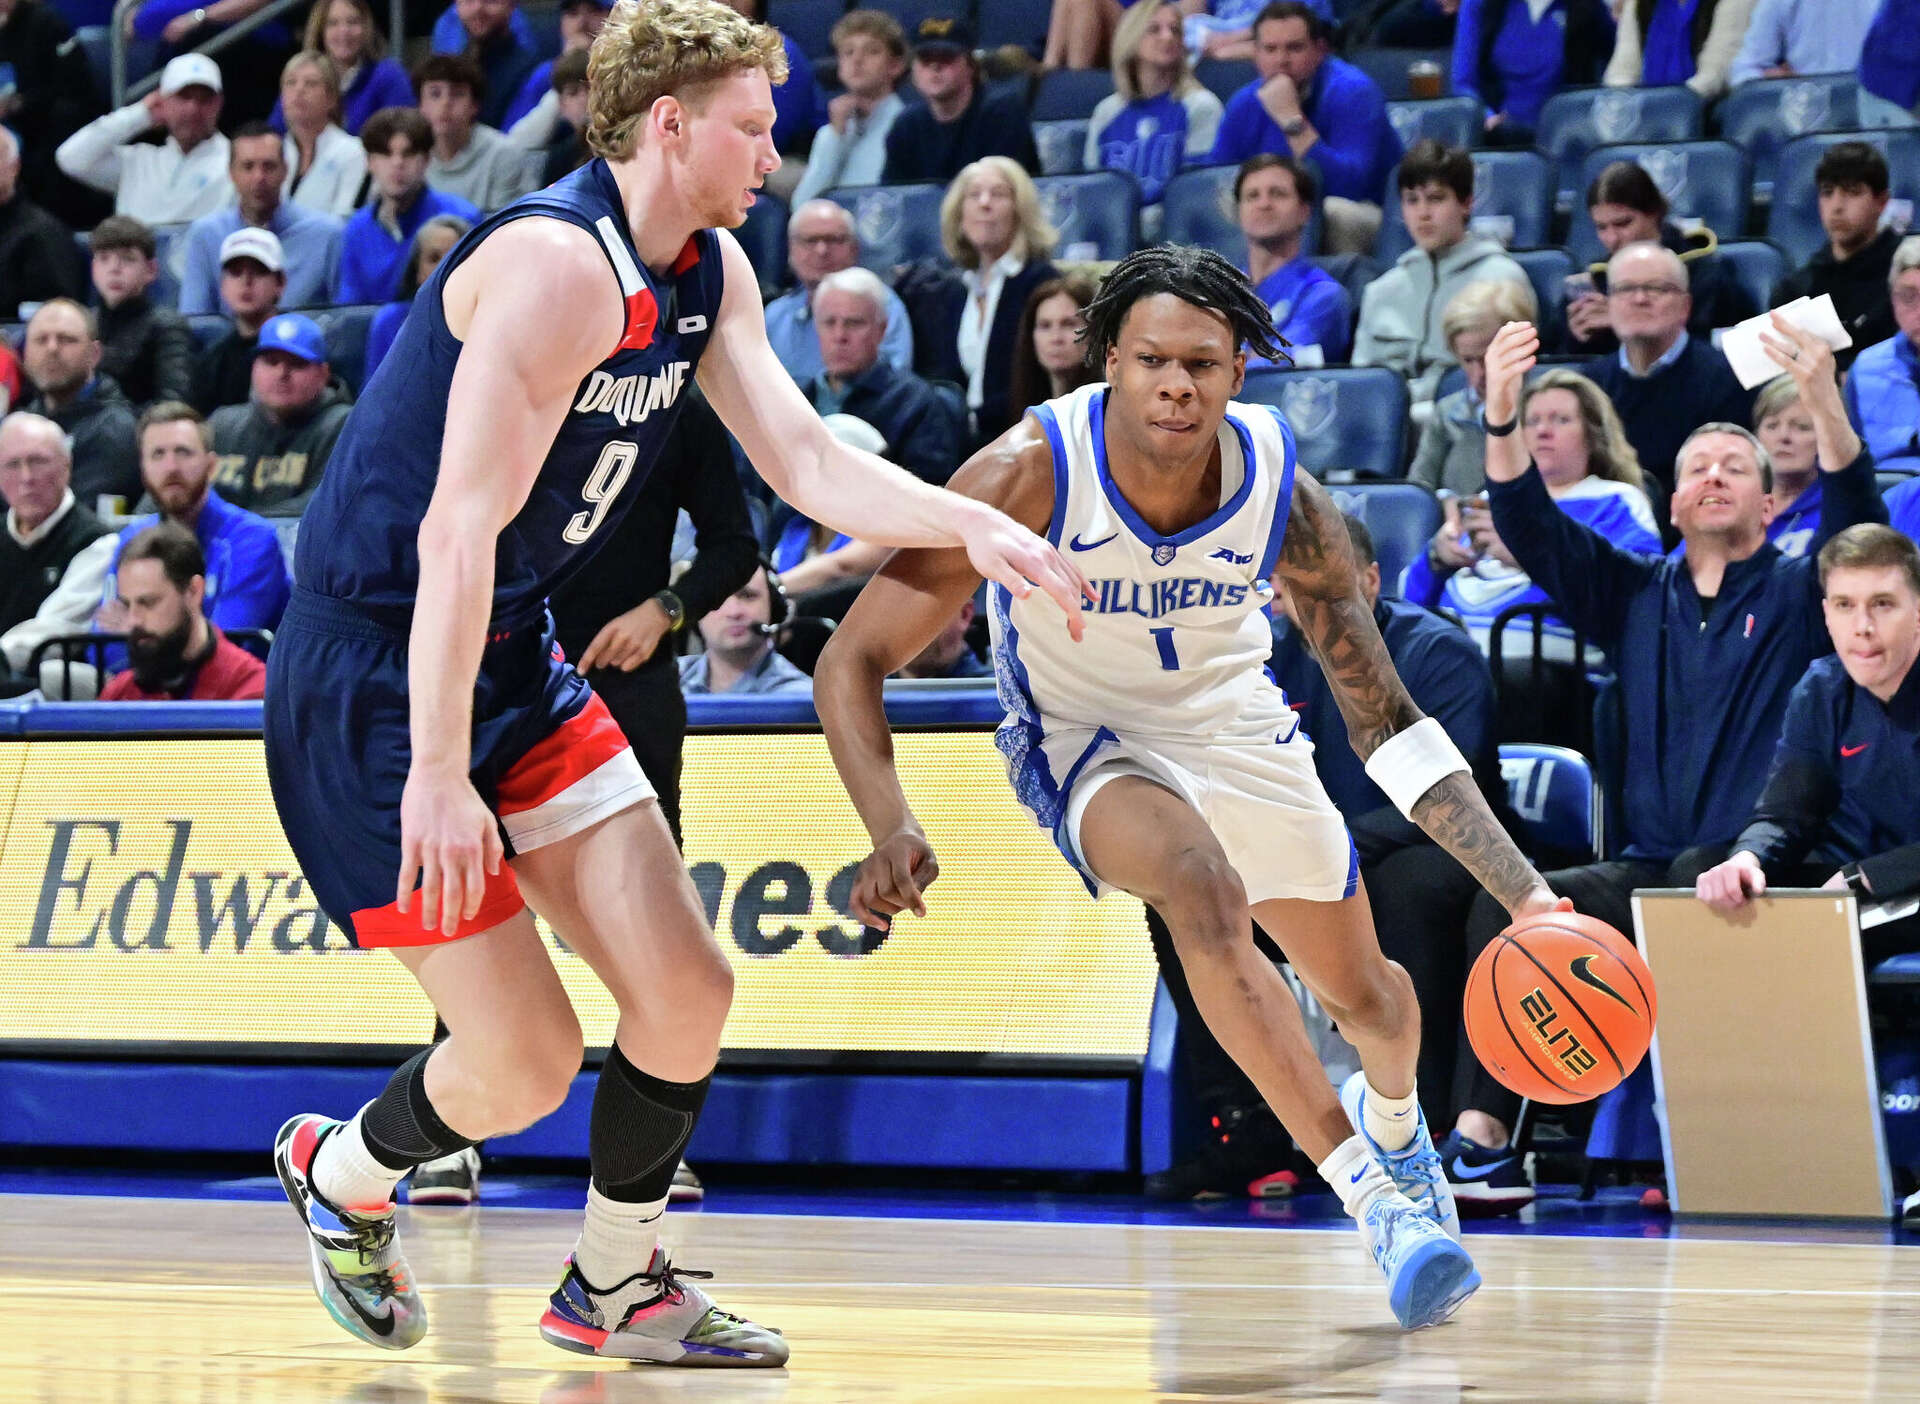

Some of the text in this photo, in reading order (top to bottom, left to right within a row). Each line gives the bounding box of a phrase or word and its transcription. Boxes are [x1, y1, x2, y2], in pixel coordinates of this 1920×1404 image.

[562, 440, 638, 544] 9
[1149, 627, 1180, 671] 1
[15, 817, 372, 955] Edwa
[1519, 986, 1599, 1077] ELITE
